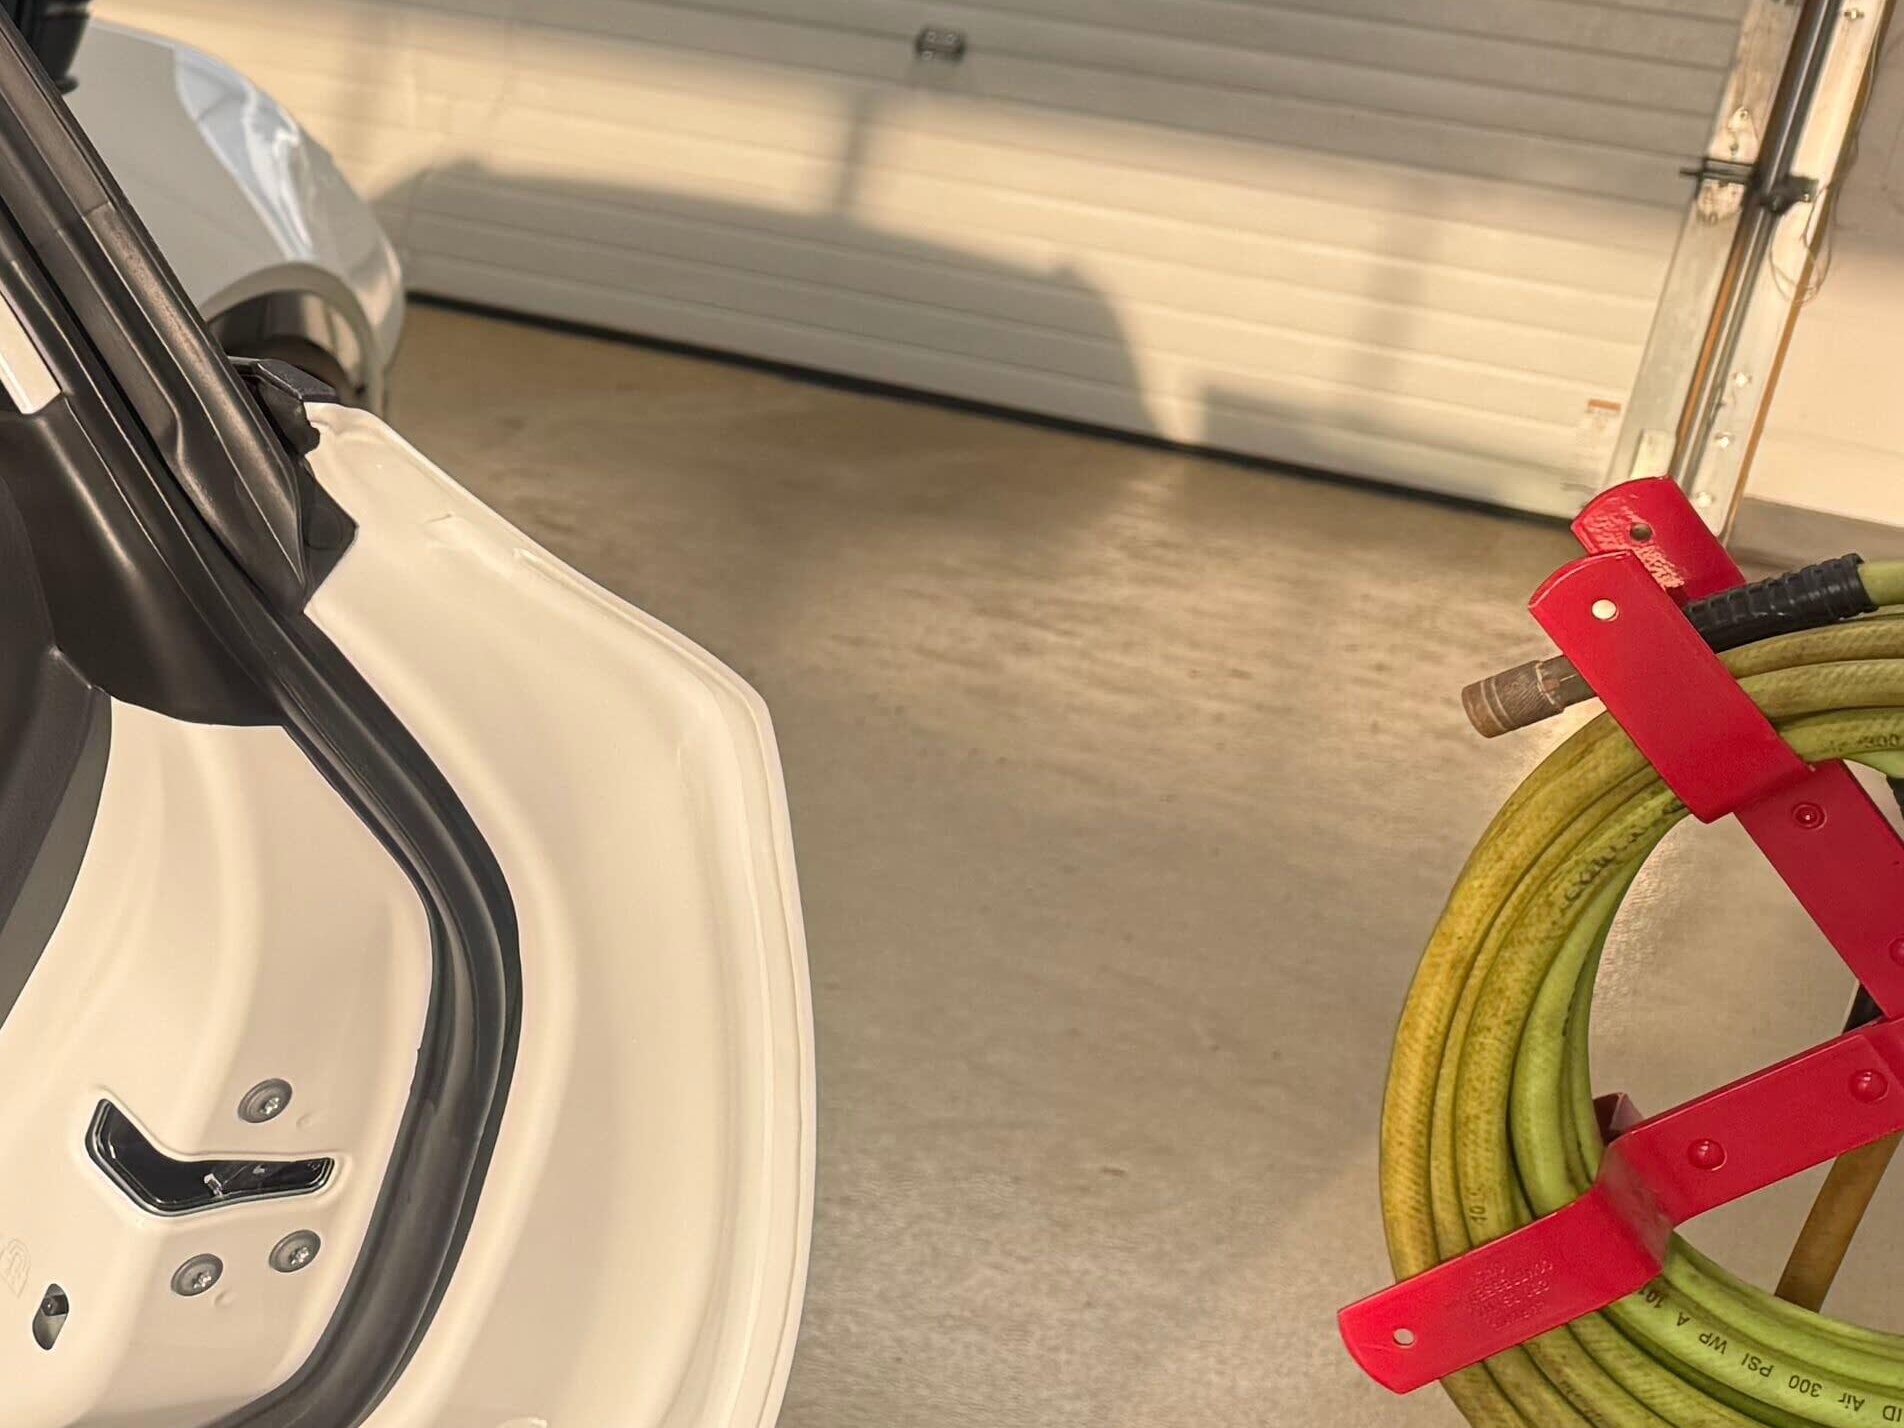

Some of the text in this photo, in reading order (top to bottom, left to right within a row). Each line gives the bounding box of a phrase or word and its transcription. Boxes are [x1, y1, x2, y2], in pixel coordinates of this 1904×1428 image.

[1676, 1312, 1691, 1327] A
[1698, 1332, 1728, 1355] WP
[1741, 1352, 1775, 1378] PSI
[1788, 1374, 1823, 1398] 300
[1838, 1392, 1866, 1412] Air
[1882, 1404, 1903, 1422] ID
